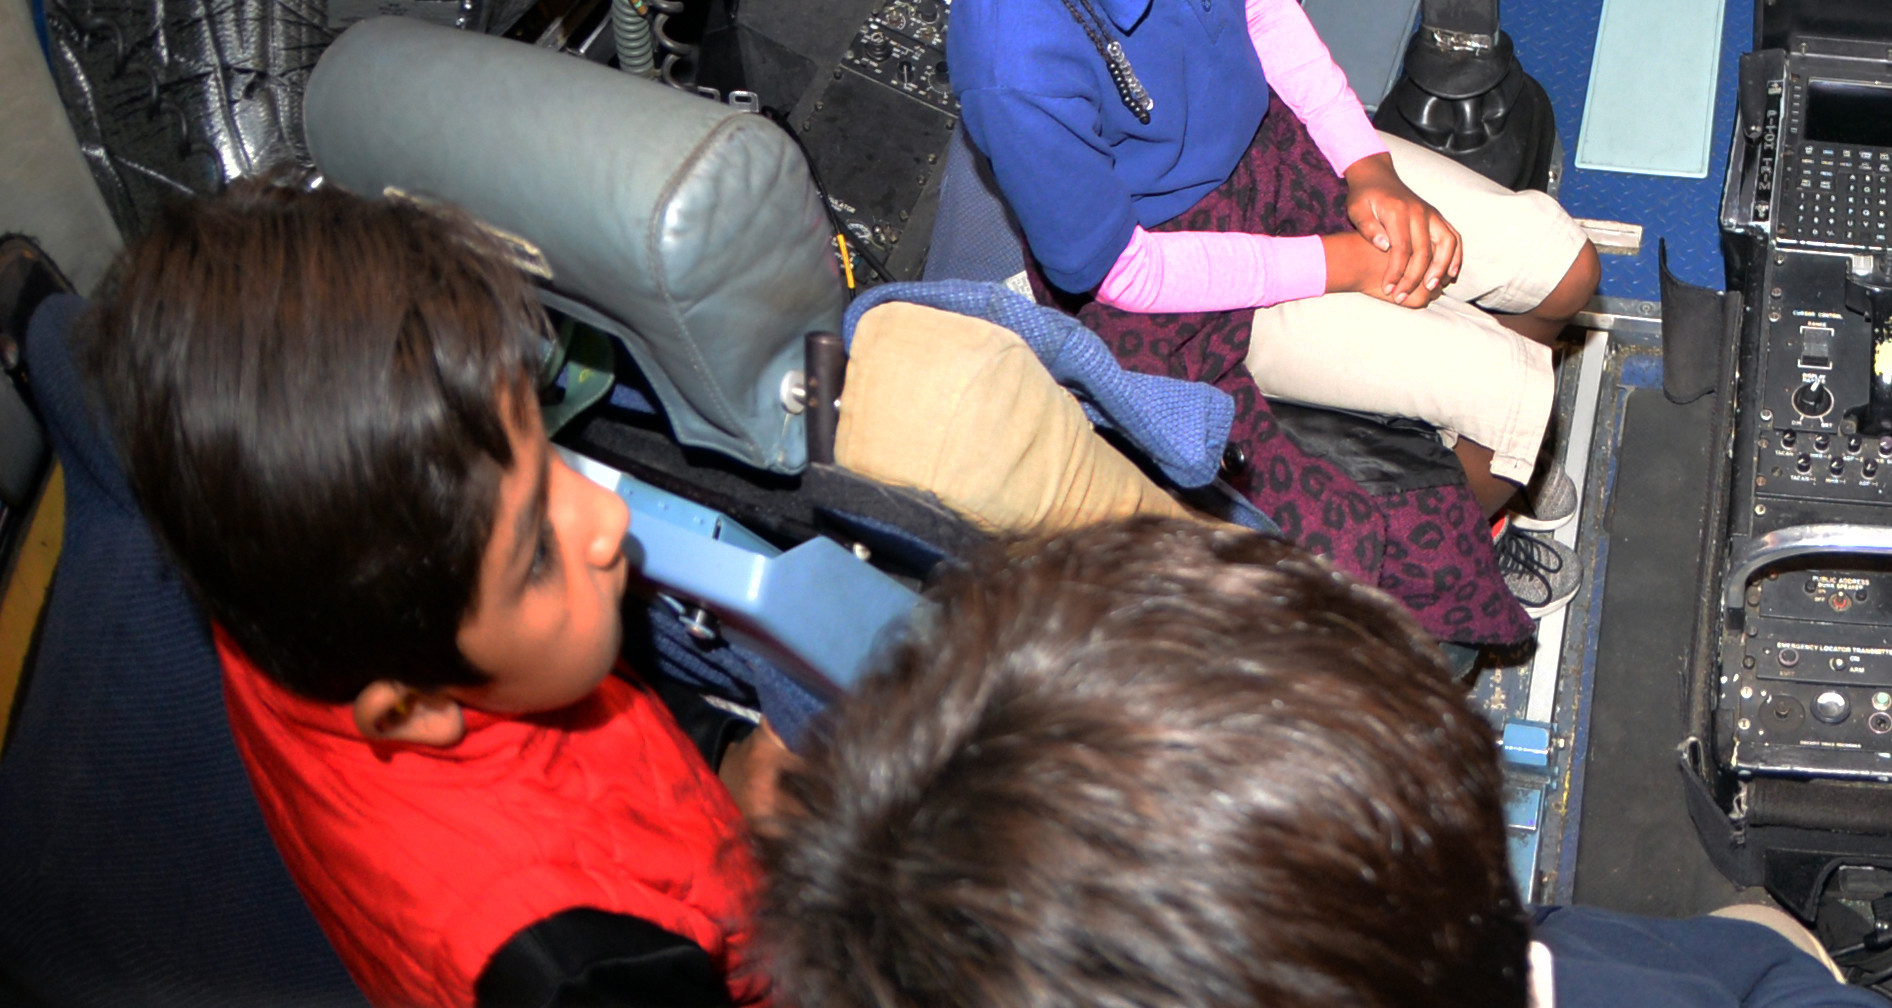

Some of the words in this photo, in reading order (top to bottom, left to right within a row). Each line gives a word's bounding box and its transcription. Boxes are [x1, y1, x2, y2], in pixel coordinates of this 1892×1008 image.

[1763, 109, 1778, 150] PITCH
[1759, 157, 1773, 191] TRIM
[1812, 575, 1837, 584] PUBLIC
[1838, 578, 1870, 586] ADDRESS
[1776, 641, 1819, 652] EMERGENCY
[1819, 644, 1852, 653] LOCATOR
